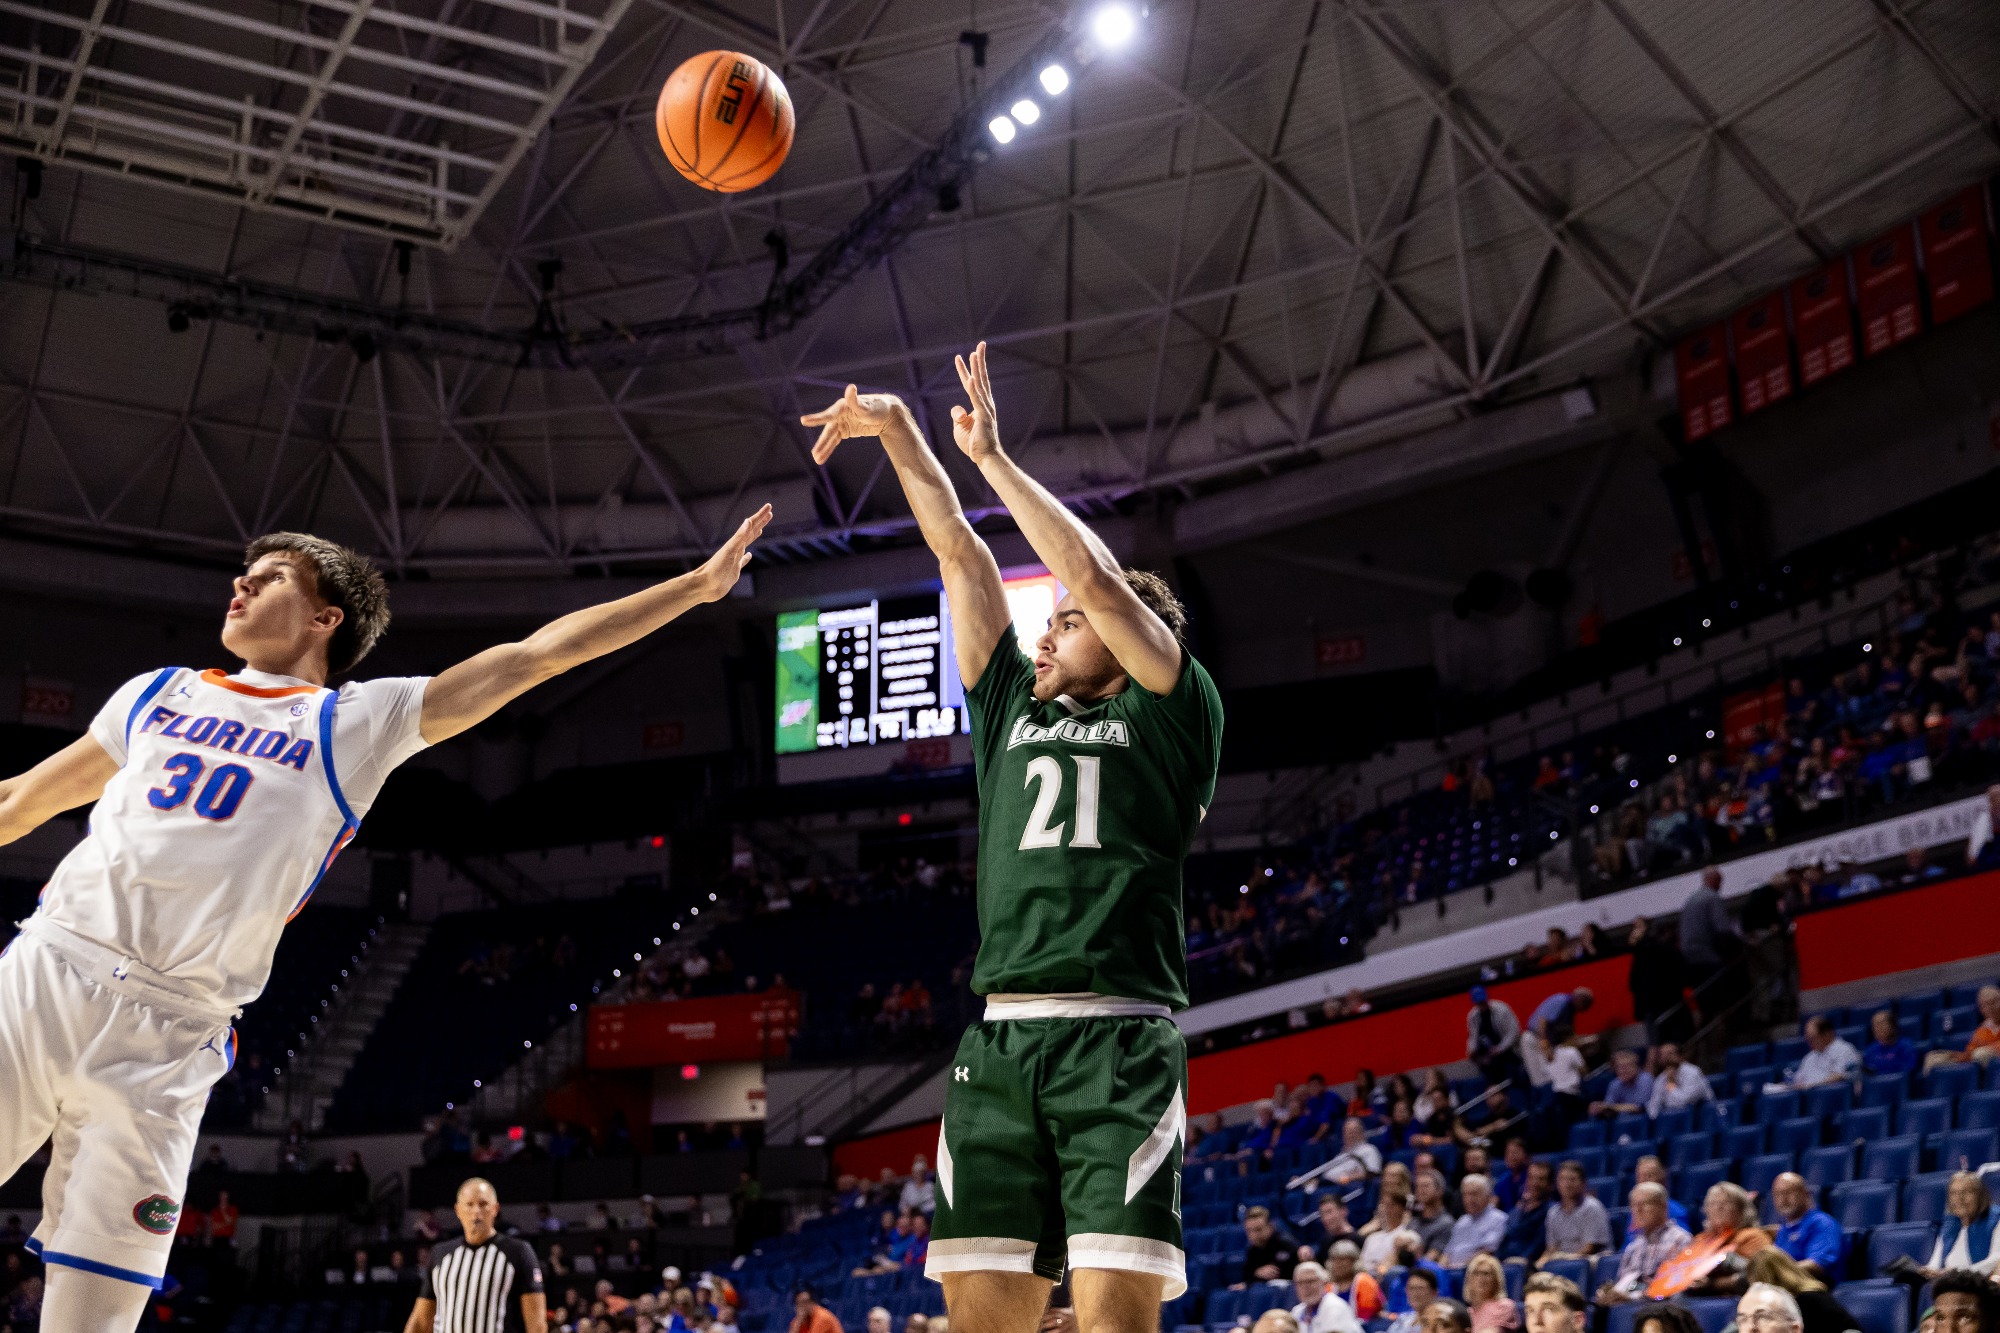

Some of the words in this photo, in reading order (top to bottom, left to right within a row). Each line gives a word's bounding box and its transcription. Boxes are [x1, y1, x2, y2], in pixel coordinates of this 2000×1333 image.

[138, 705, 315, 772] FLORIDA
[1007, 714, 1130, 751] LOYOLA
[147, 751, 255, 822] 30
[1018, 754, 1102, 850] 21
